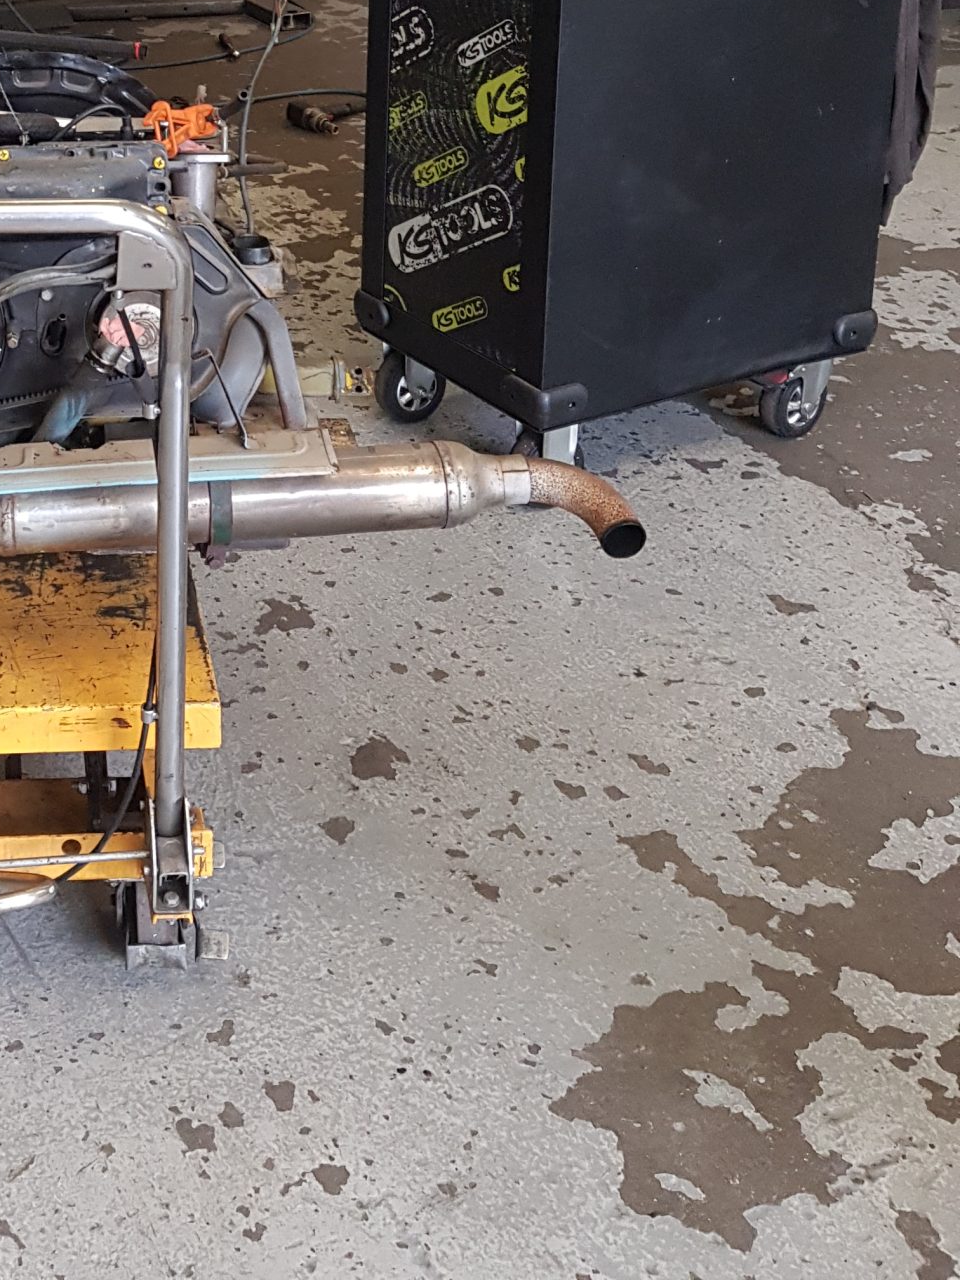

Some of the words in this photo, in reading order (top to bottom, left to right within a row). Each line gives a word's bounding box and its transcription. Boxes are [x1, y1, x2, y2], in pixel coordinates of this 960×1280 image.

[479, 23, 514, 52] TOOLS
[436, 150, 466, 177] TOOLS
[453, 301, 485, 322] TOOLS
